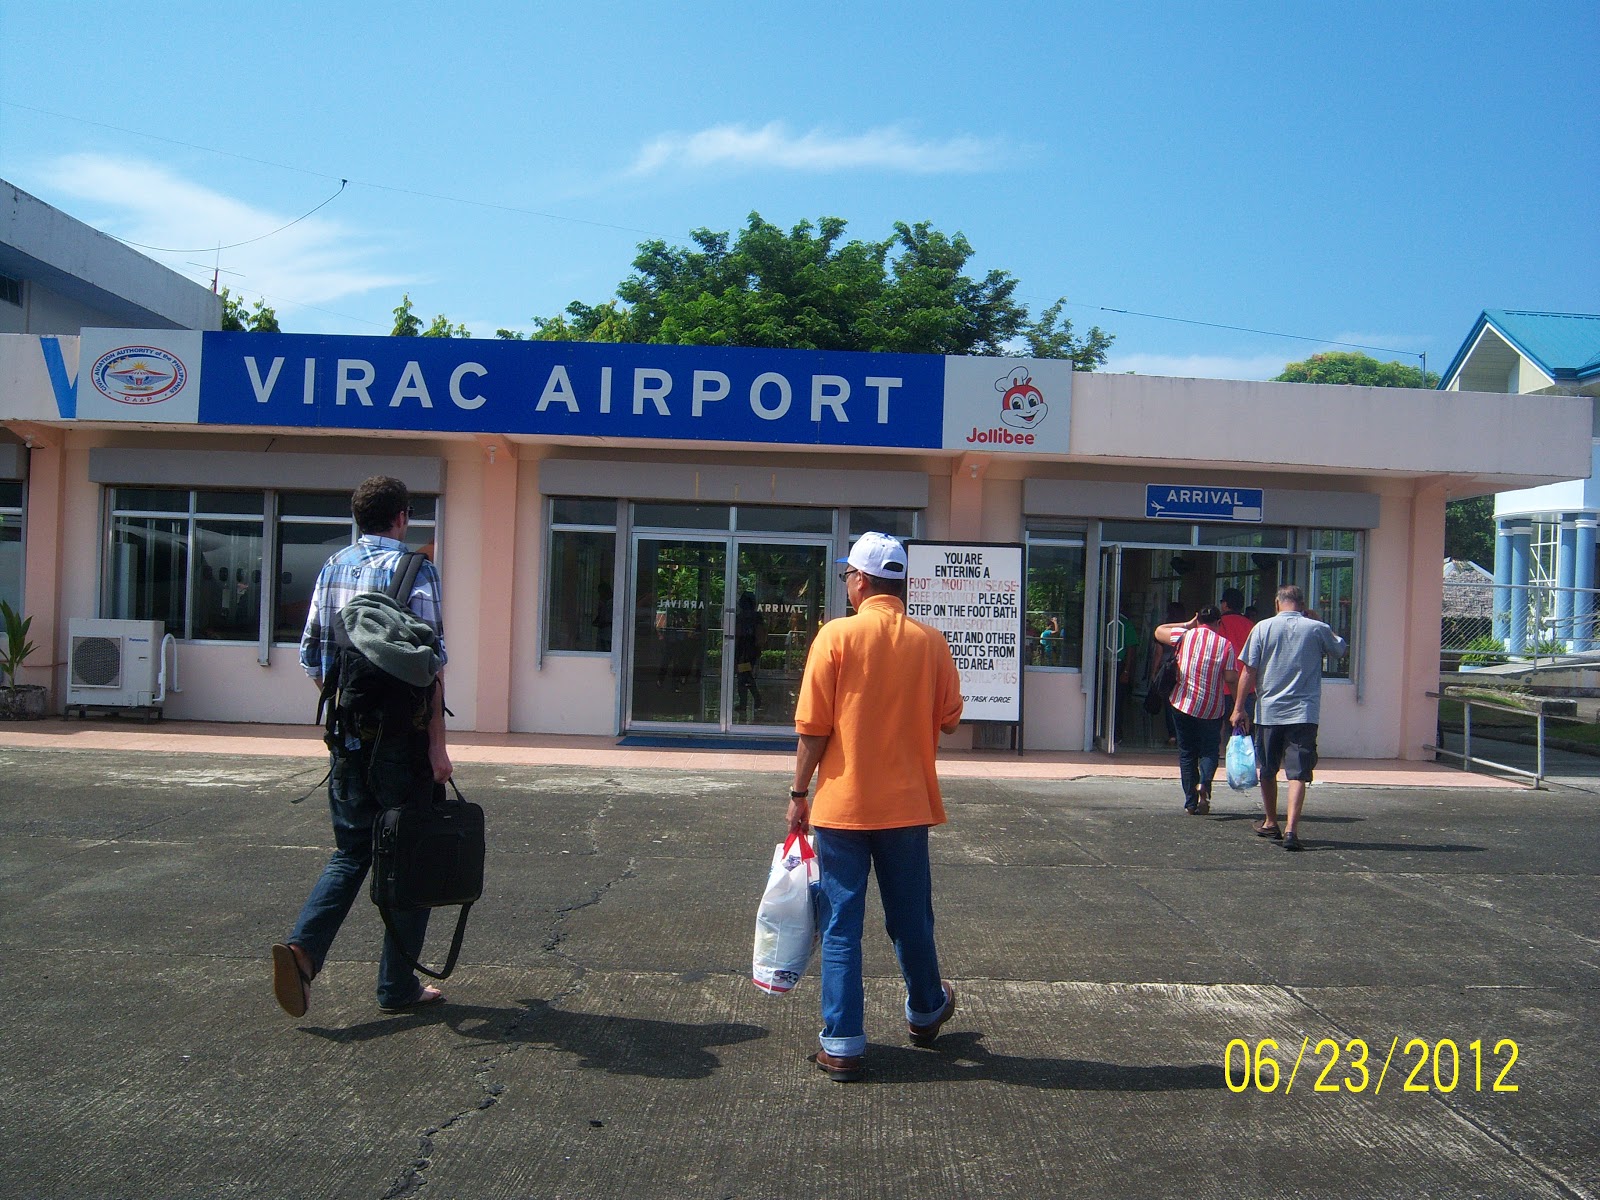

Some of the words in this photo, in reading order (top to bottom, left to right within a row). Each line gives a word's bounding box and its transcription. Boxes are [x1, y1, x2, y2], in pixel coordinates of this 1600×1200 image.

[116, 347, 154, 356] AUTHORITY
[162, 354, 172, 362] the
[94, 352, 116, 376] AVIATION
[170, 359, 184, 394] PHILIPPINES
[95, 377, 107, 392] CIVIL
[244, 356, 488, 410] VIRAC
[535, 364, 903, 424] AIRPORT
[966, 427, 1035, 445] Jollibee
[1166, 489, 1243, 505] ARRIVAL
[944, 552, 963, 565] YOU
[964, 553, 983, 566] ARE
[935, 565, 981, 578] ENTERING
[983, 566, 991, 579] A
[909, 577, 931, 590] FOOT
[942, 578, 975, 591] MOUTH
[977, 579, 1020, 592] DSEASE-
[909, 591, 930, 603] FREE
[932, 591, 976, 604] PROVCE
[979, 593, 1015, 605] PLEASE
[757, 603, 803, 614] ARRIVAL
[908, 604, 932, 616] STEP
[933, 604, 946, 616] ON
[948, 605, 966, 617] THE
[967, 606, 992, 618] FOOT
[993, 606, 1018, 619] BATH
[964, 632, 983, 644] AND
[985, 632, 1016, 645] OTHER
[949, 644, 986, 657] ODUCTS
[987, 645, 1015, 658] FROM
[970, 658, 994, 671] AREA
[971, 695, 988, 703] TASK
[988, 696, 1012, 704] FORCE
